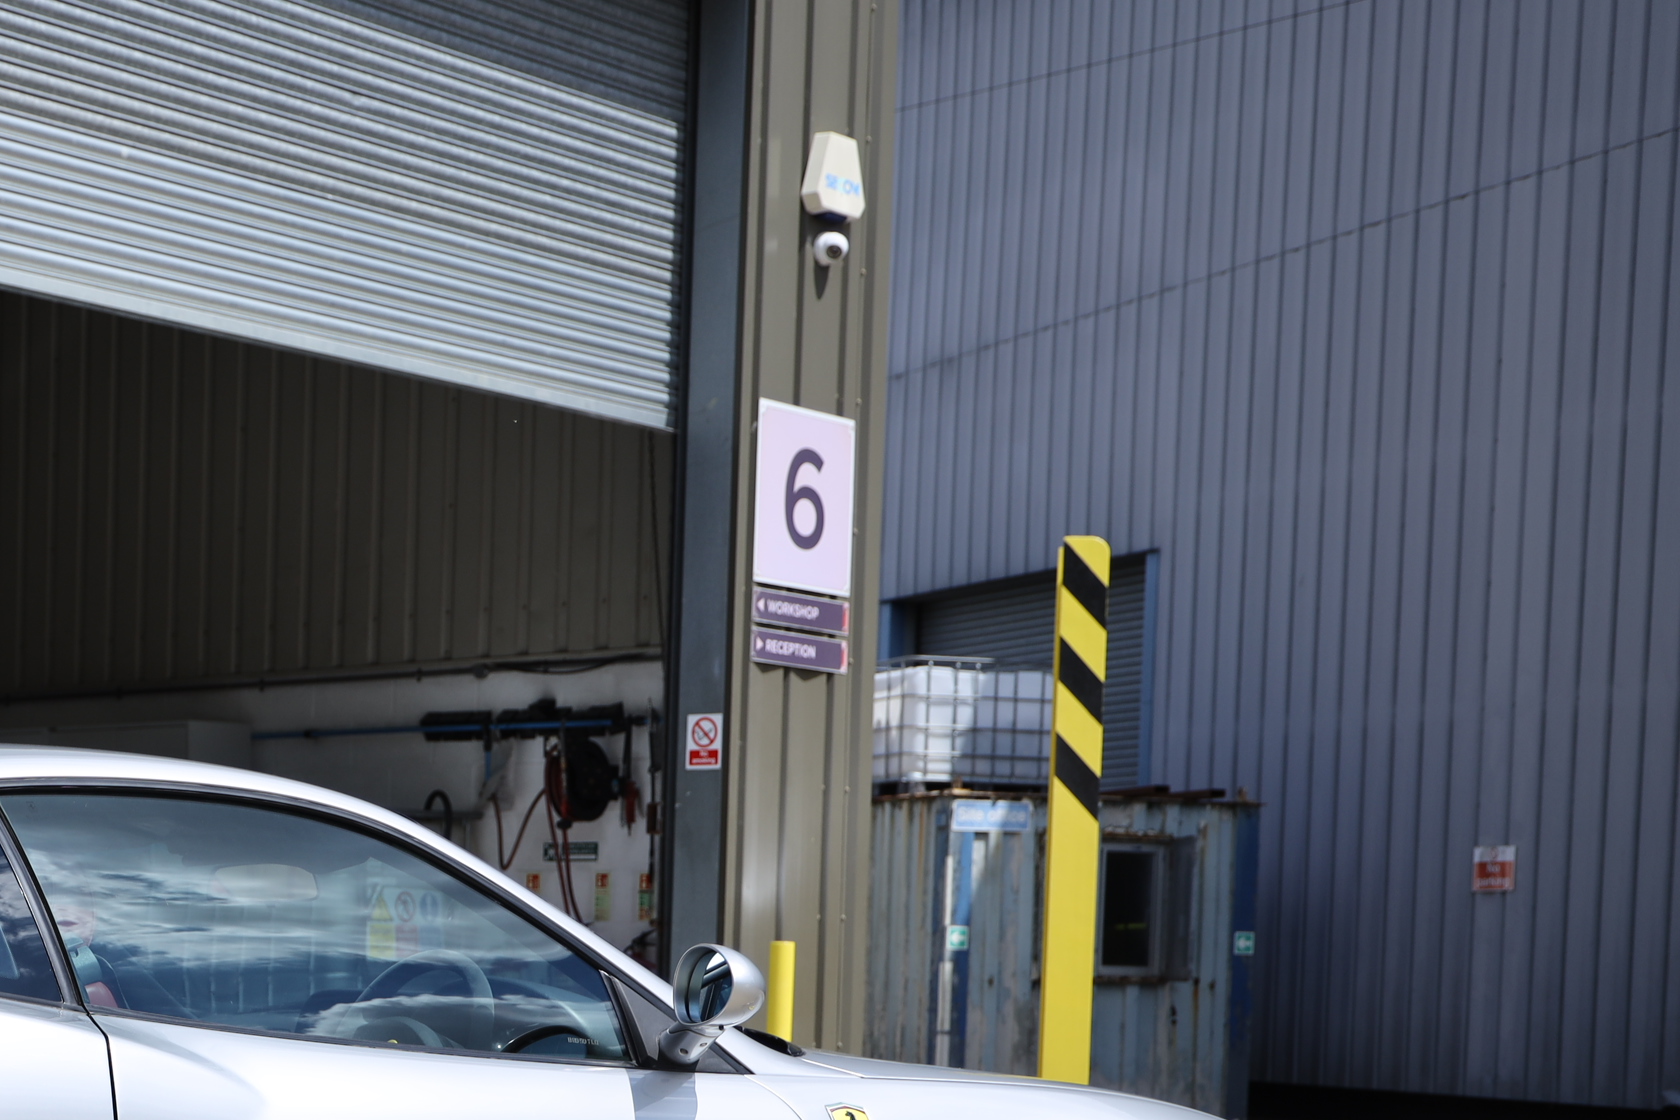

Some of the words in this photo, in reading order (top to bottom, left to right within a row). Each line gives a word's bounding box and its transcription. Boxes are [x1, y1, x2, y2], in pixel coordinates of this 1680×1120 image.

[785, 447, 824, 550] 6
[766, 599, 820, 620] WORKSHOP
[765, 638, 816, 659] RECEPTION
